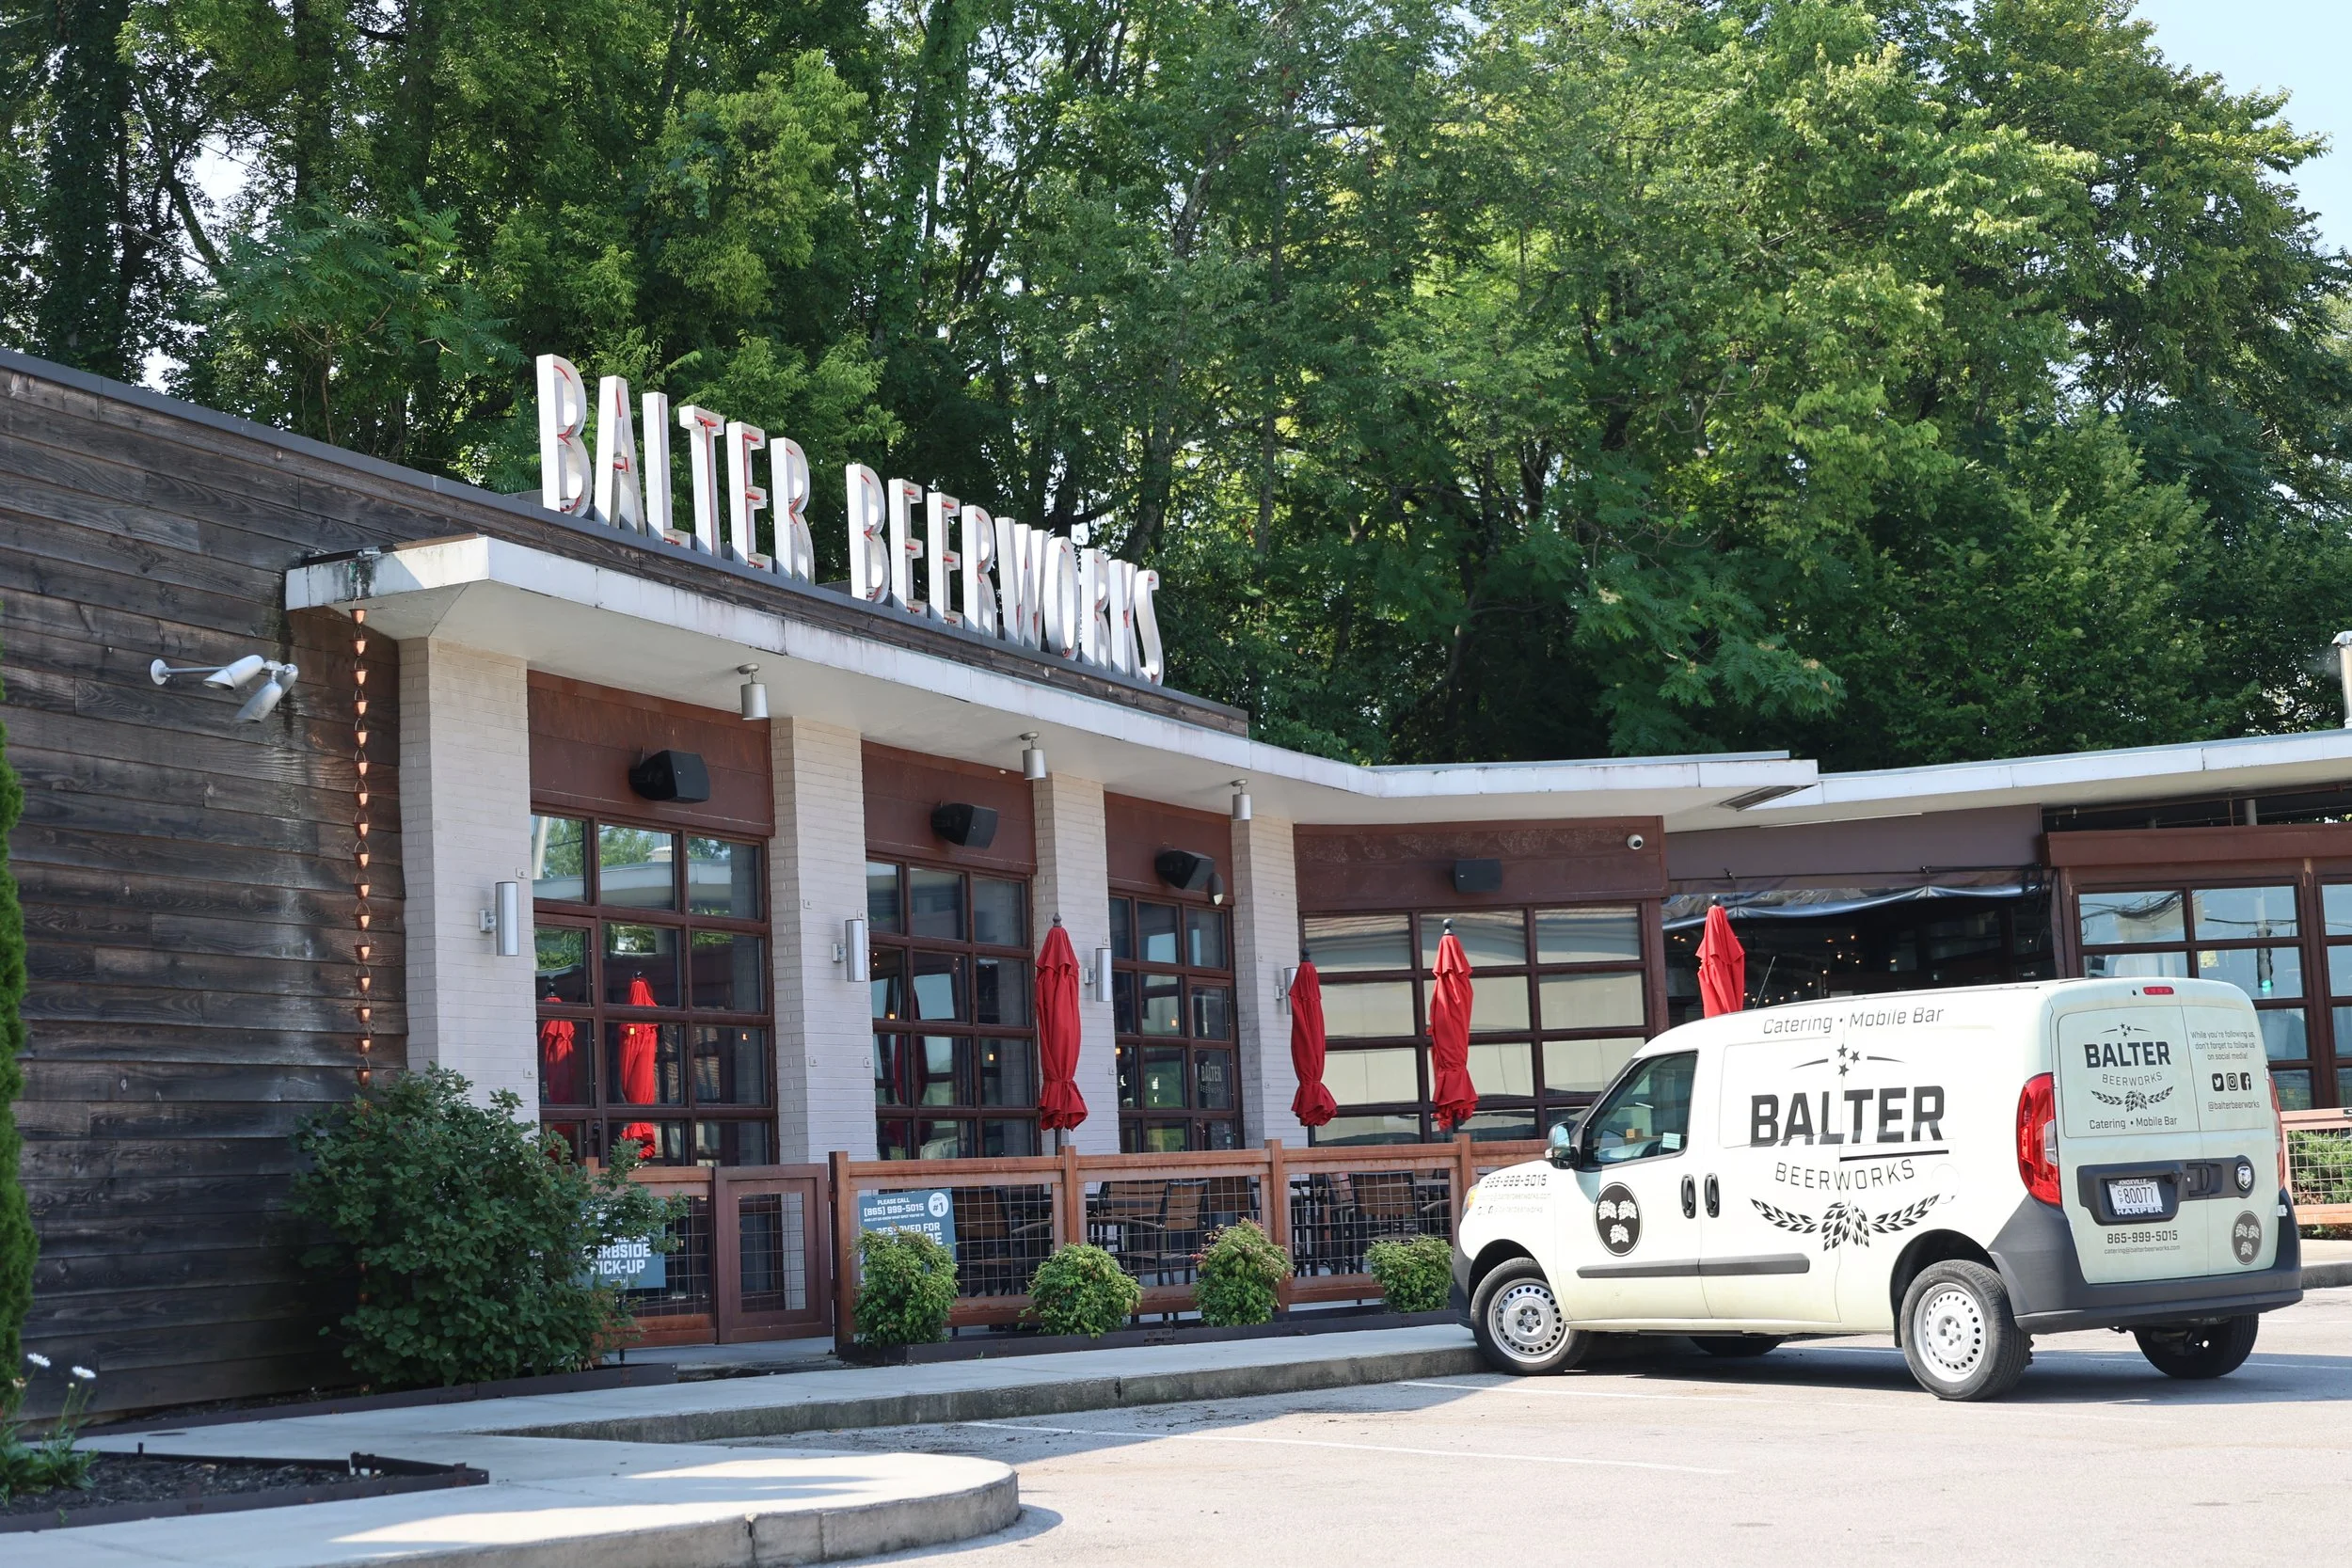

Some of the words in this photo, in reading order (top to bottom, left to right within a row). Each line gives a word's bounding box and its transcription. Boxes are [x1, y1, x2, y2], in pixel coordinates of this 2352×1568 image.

[535, 354, 816, 585] BALTER
[846, 463, 1165, 687] BEERWORKS
[1762, 1016, 1833, 1035] Catering
[1849, 1009, 1907, 1028] Mobile
[1913, 1007, 1945, 1023] Bar
[2084, 1041, 2171, 1069] BALTER
[2102, 1071, 2163, 1086] BEERWORKS
[2207, 1100, 2260, 1112] @balterbeerworks
[1749, 1085, 1945, 1148] BALTER
[2089, 1118, 2126, 1130] Catering
[2136, 1117, 2163, 1127] Mobile
[2164, 1116, 2178, 1126] Bar
[1774, 1158, 1915, 1191] BEERWORKS
[2123, 1186, 2154, 1204] 80077
[887, 1203, 924, 1214] 999-5015
[932, 1202, 943, 1212] #1
[2116, 1207, 2163, 1215] HARPER
[923, 1222, 941, 1232] FOR
[2107, 1230, 2178, 1243] 865-999-5015
[2104, 1244, 2181, 1255] catering@balterbeerworks.com
